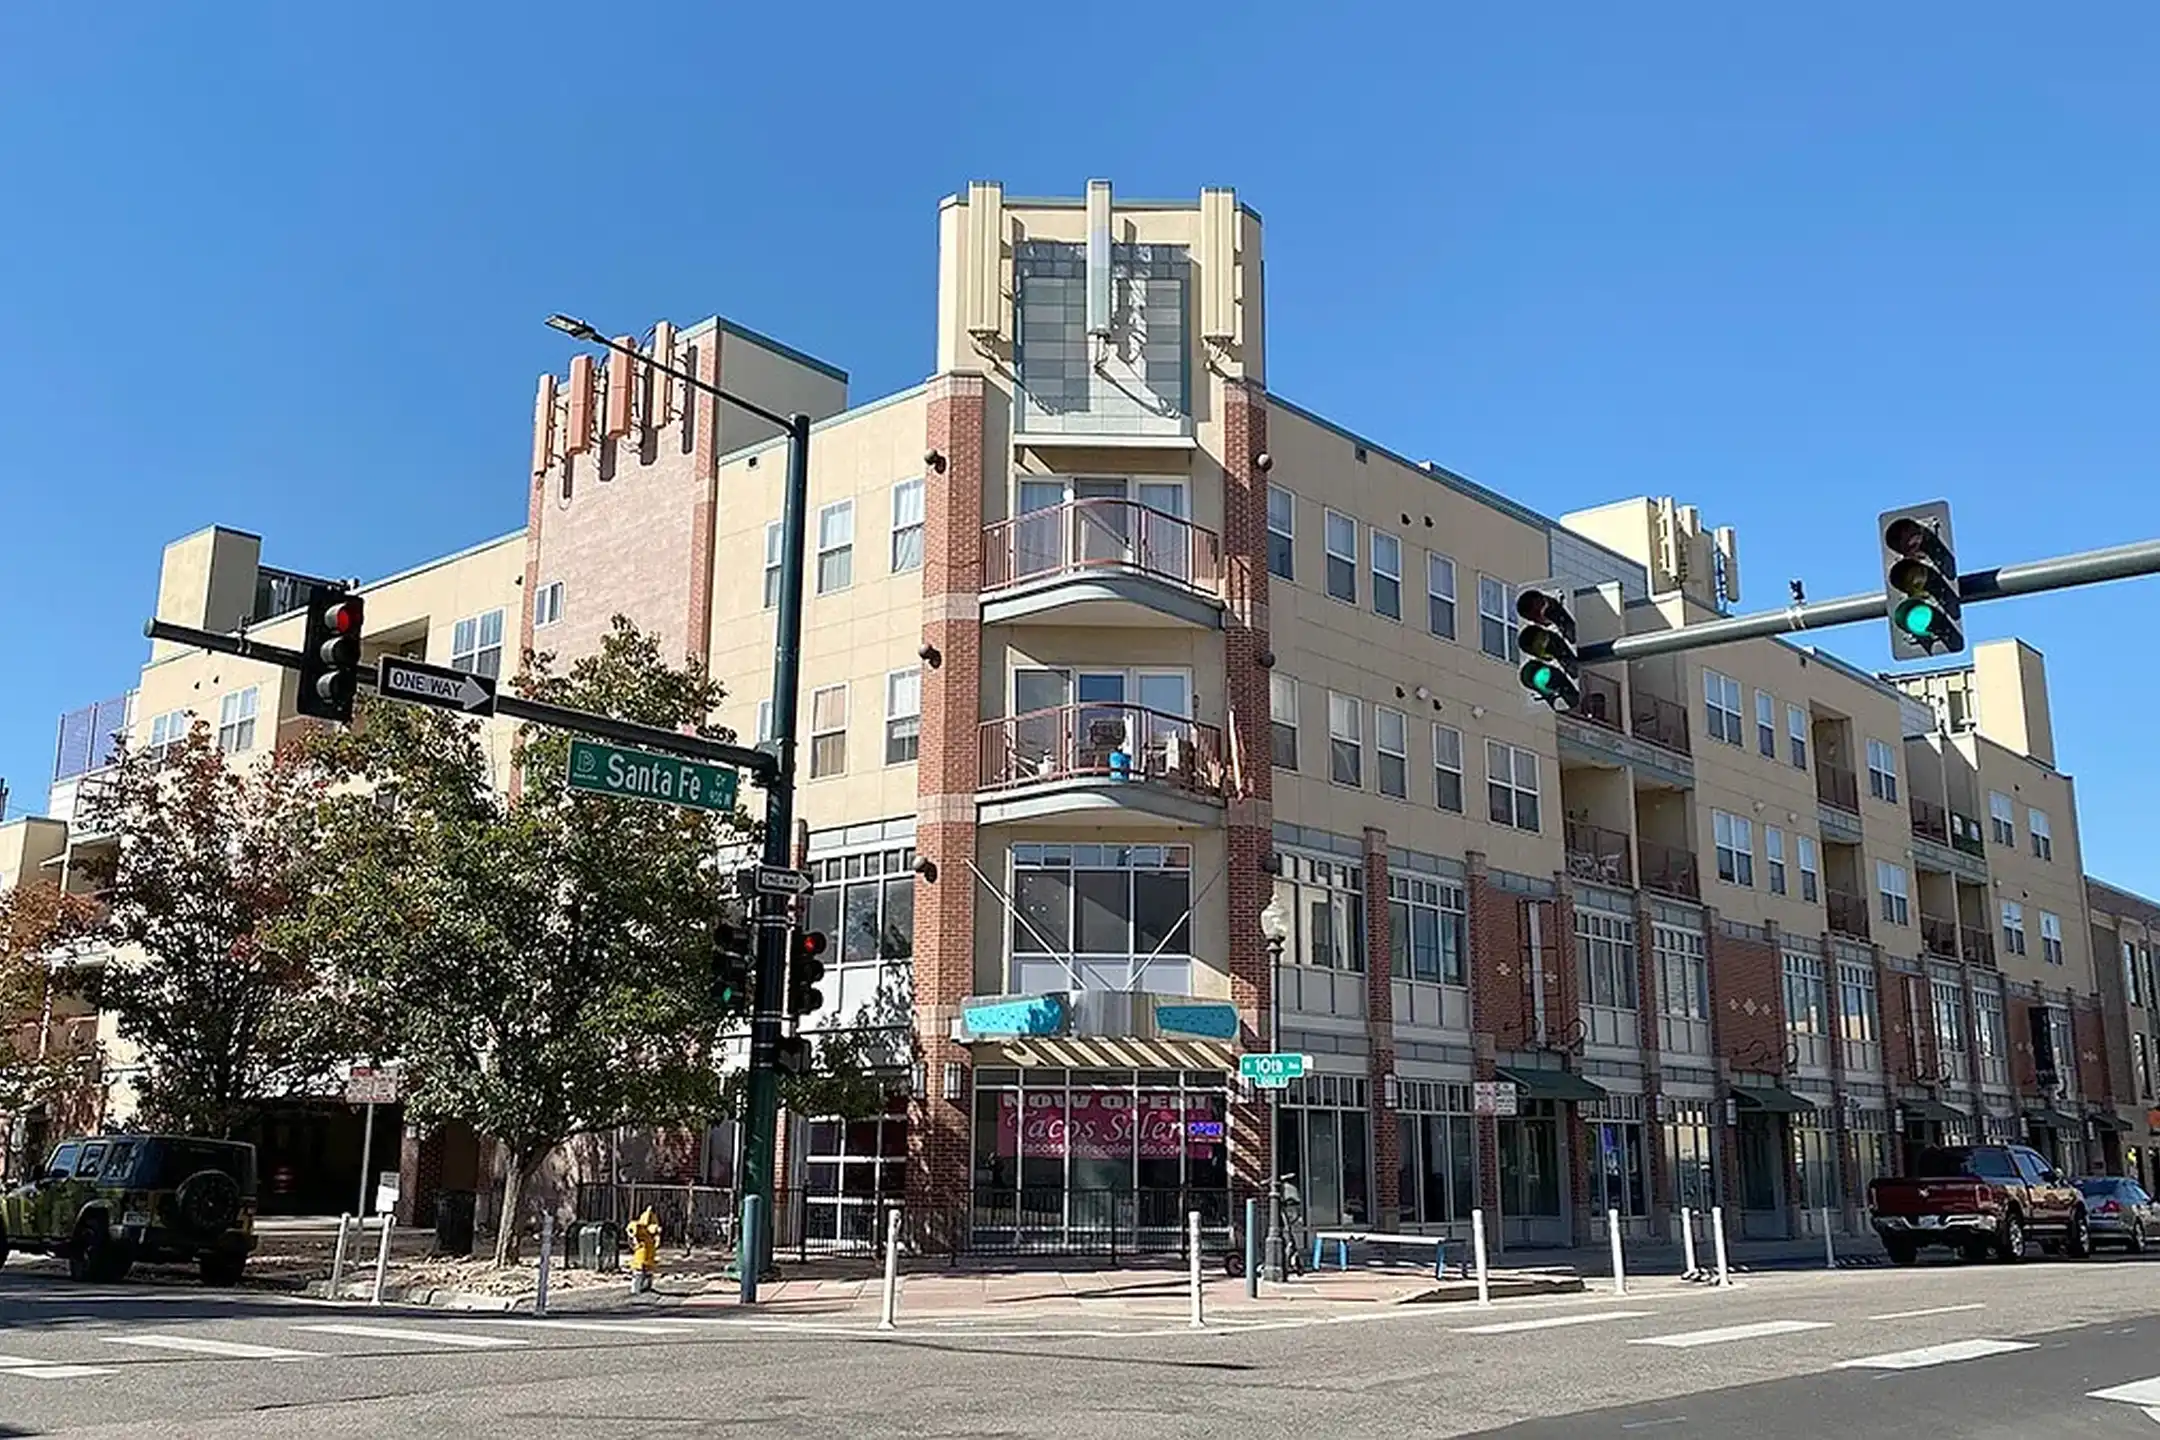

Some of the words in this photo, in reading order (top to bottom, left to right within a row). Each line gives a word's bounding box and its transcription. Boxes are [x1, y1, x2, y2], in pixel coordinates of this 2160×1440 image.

[393, 671, 427, 692] ONE
[430, 679, 462, 698] WAY
[606, 753, 674, 797] Santa
[678, 765, 702, 801] Fe
[1254, 1058, 1284, 1075] 10th
[1001, 1093, 1092, 1109] NOW
[1006, 1110, 1096, 1139] Tacos
[1102, 1111, 1186, 1143] Selen
